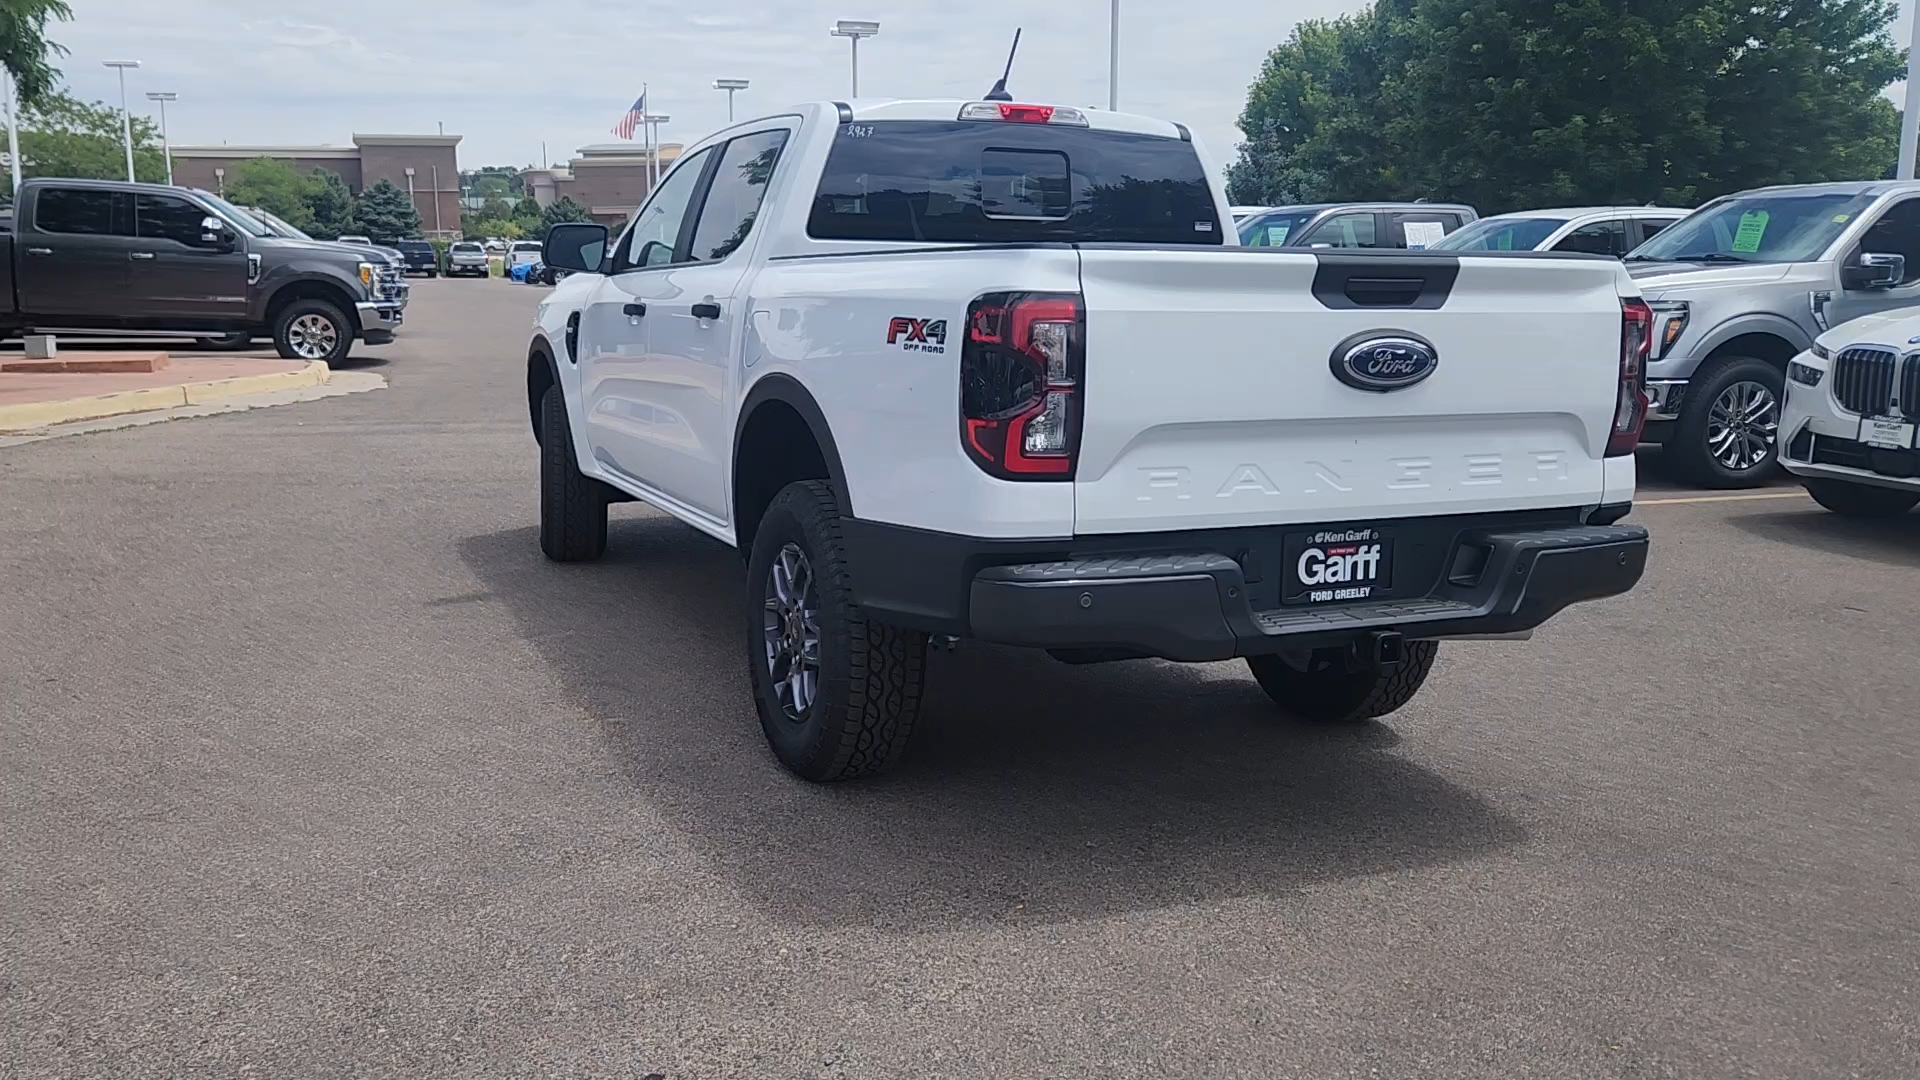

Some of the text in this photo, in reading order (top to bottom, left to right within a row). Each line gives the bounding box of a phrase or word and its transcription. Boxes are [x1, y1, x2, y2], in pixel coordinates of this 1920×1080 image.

[887, 316, 947, 345] FX4
[903, 343, 945, 354] OFF ROAD
[1367, 348, 1418, 374] Ford
[1136, 449, 1569, 502] RANGER
[1345, 529, 1372, 542] Garff
[1297, 544, 1381, 586] Garff
[1310, 587, 1371, 602] FORD GREELEY
